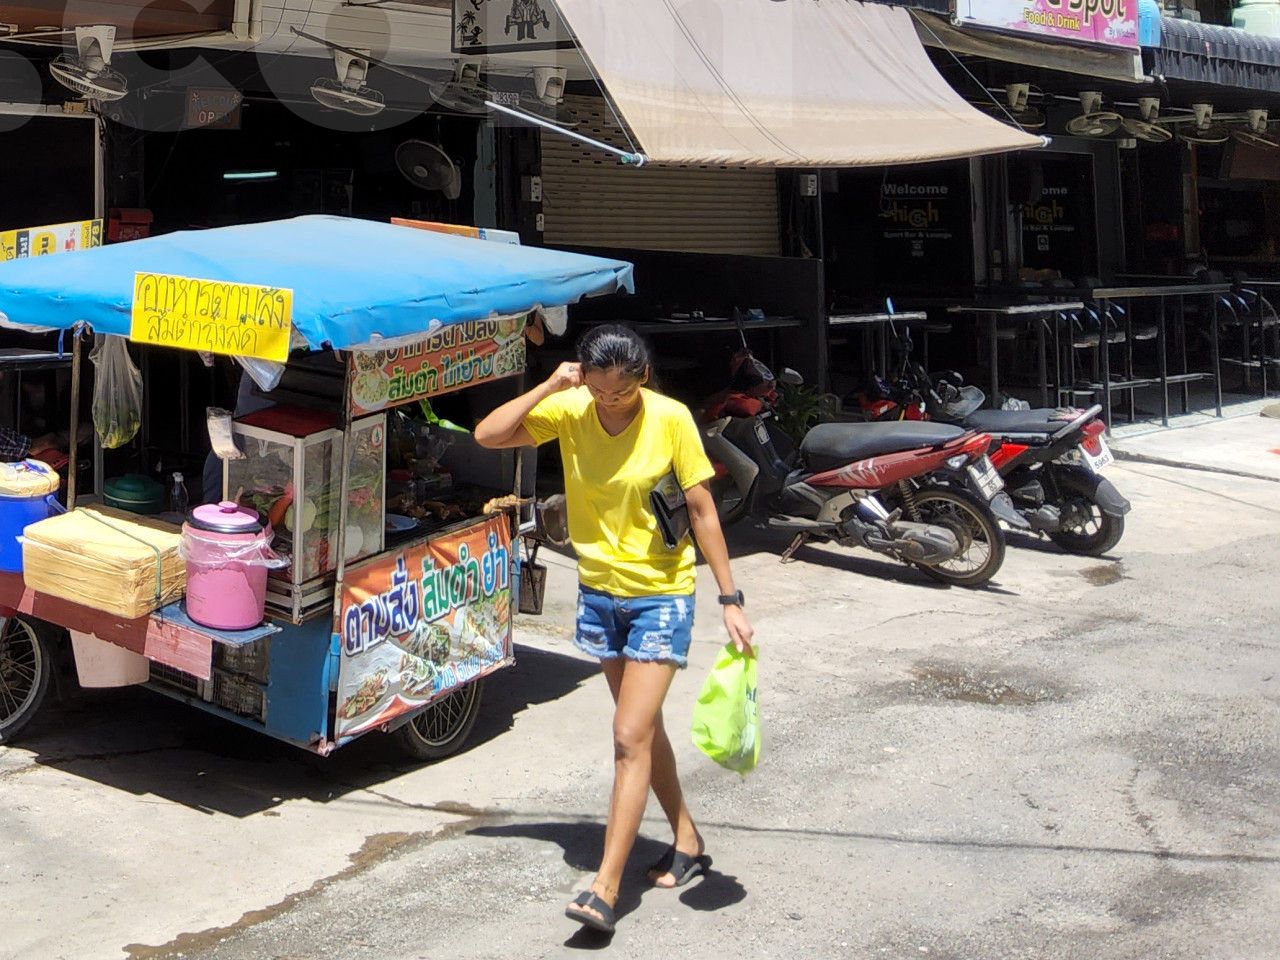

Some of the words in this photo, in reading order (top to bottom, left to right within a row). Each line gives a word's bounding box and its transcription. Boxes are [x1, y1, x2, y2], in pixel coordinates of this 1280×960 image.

[1023, 8, 1046, 26] Food
[1048, 13, 1055, 27] &
[1057, 14, 1081, 31] Drink
[882, 184, 948, 195] Welcome
[388, 360, 439, 401] ส้มตำ
[442, 350, 494, 388] ไก่ย่าง
[344, 554, 419, 656] ตามสั่ง
[422, 542, 480, 622] ส้มตำ
[482, 531, 508, 597] ยำ
